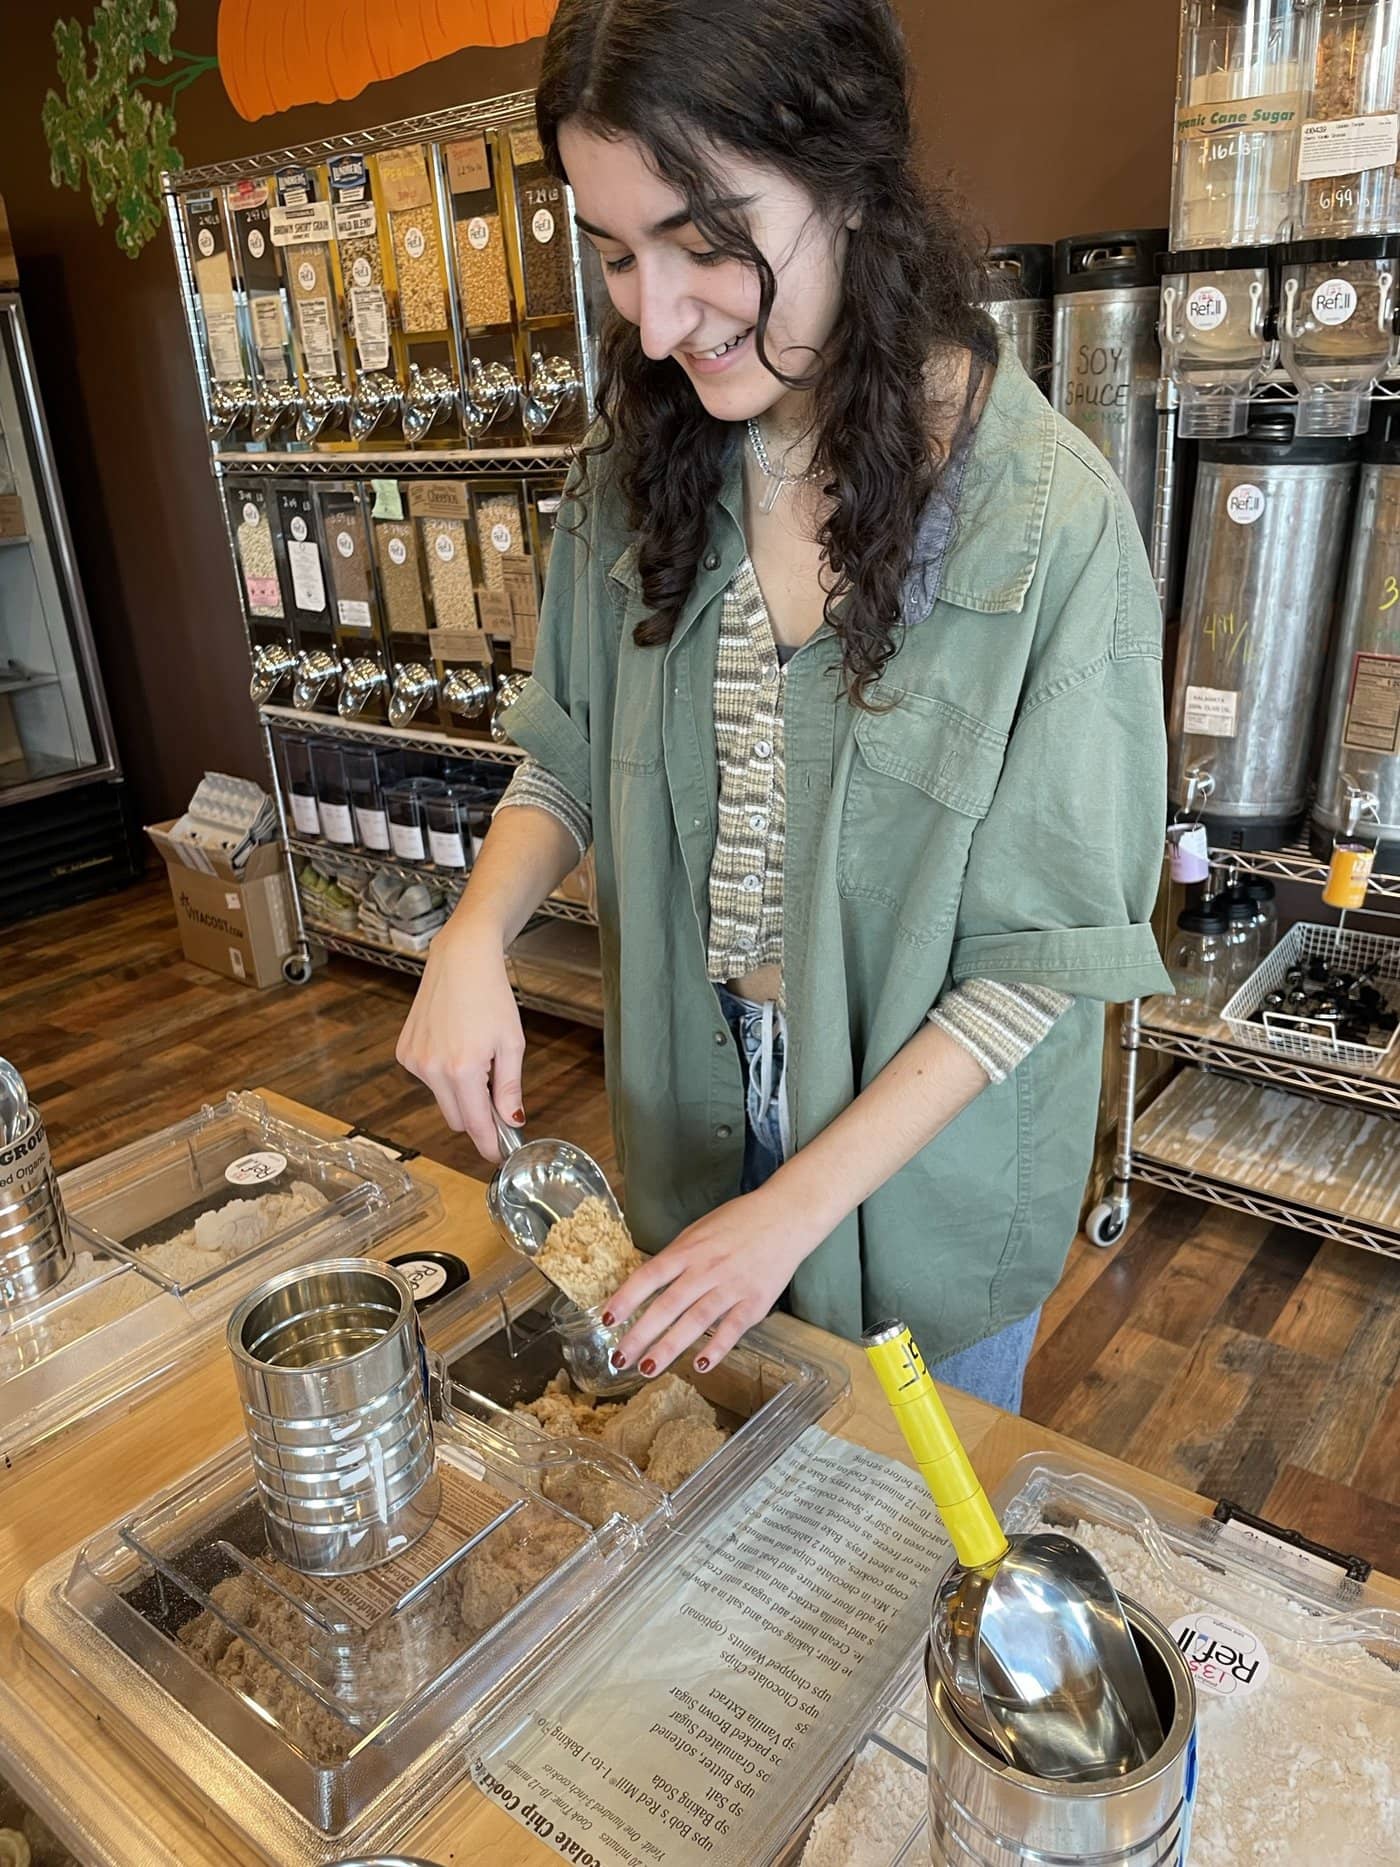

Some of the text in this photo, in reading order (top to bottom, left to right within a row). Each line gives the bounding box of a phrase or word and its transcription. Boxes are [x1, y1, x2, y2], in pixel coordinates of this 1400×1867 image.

[1210, 111, 1247, 125] Cane
[1252, 108, 1295, 124] Sugar
[1077, 345, 1122, 375] SOY
[1066, 381, 1131, 406] SAUCE
[16, 1152, 47, 1179] Organic
[805, 1467, 828, 1484] Bake
[850, 1454, 935, 1504] utes before serving
[804, 1484, 838, 1503] cookies
[848, 1486, 876, 1504] sheet
[867, 1478, 906, 1502] minutes.
[812, 1504, 826, 1516] To
[836, 1494, 865, 1516] Space
[873, 1498, 899, 1518] lined
[824, 1508, 861, 1534] needed.
[896, 1512, 949, 1548] parchment
[819, 1524, 843, 1544] Bake
[860, 1530, 872, 1541] as
[890, 1530, 903, 1542] to
[902, 1536, 926, 1552] oven
[736, 1541, 760, 1558] until
[760, 1516, 910, 1601] coop cookies, about 2 tablespoons
[843, 1538, 870, 1560] trays.
[870, 1538, 902, 1561] freeze
[900, 1555, 914, 1564] or
[738, 1524, 890, 1614] Mix in chocolate chips and walnuts
[752, 1568, 771, 1582] mix
[776, 1560, 797, 1577] and
[866, 1556, 896, 1575] sheet
[894, 1570, 910, 1581] on
[716, 1589, 728, 1601] in
[741, 1581, 773, 1606] sugars
[768, 1577, 790, 1594] and
[794, 1572, 832, 1602] mixture
[331, 1581, 381, 1623] Nutrition
[724, 1594, 744, 1610] salt
[768, 1602, 790, 1619] and
[786, 1589, 820, 1616] extract
[831, 1596, 856, 1615] flour
[741, 1606, 762, 1624] and
[788, 1614, 820, 1637] butter
[818, 1610, 849, 1632] vanilla
[854, 1609, 876, 1624] add
[872, 1618, 889, 1634] lly
[759, 1618, 784, 1638] soda
[846, 1626, 868, 1643] and
[678, 1600, 832, 1703] ups chopped Walnuts (optional)
[782, 1630, 816, 1656] baking
[818, 1630, 850, 1655] Cream
[814, 1648, 842, 1672] flour,
[850, 1649, 864, 1664] le.
[718, 1648, 820, 1719] ups Chocolate Chips
[667, 1684, 700, 1710] Sugar
[667, 1709, 700, 1736] Sugar
[696, 1703, 732, 1734] Brown
[708, 1687, 796, 1750] sp Vanilla Extract
[794, 1720, 810, 1735] gs
[548, 1724, 585, 1758] Baking
[696, 1728, 756, 1775] Granulated
[728, 1726, 772, 1758] packed
[580, 1750, 612, 1778] 1-to-1
[648, 1722, 756, 1798] ups Butter, softened
[541, 1762, 666, 1862] Yield: One hundred 3-inch cookies
[549, 1794, 574, 1816] Time:
[636, 1792, 662, 1815] Red
[650, 1774, 730, 1834] sp Baking Soda
[704, 1786, 744, 1817] sp Salt
[518, 1802, 556, 1838] Chip
[570, 1810, 593, 1831] Cook
[552, 1830, 601, 1867] colate
[598, 1832, 632, 1861] minutes
[691, 1830, 714, 1852] ups
